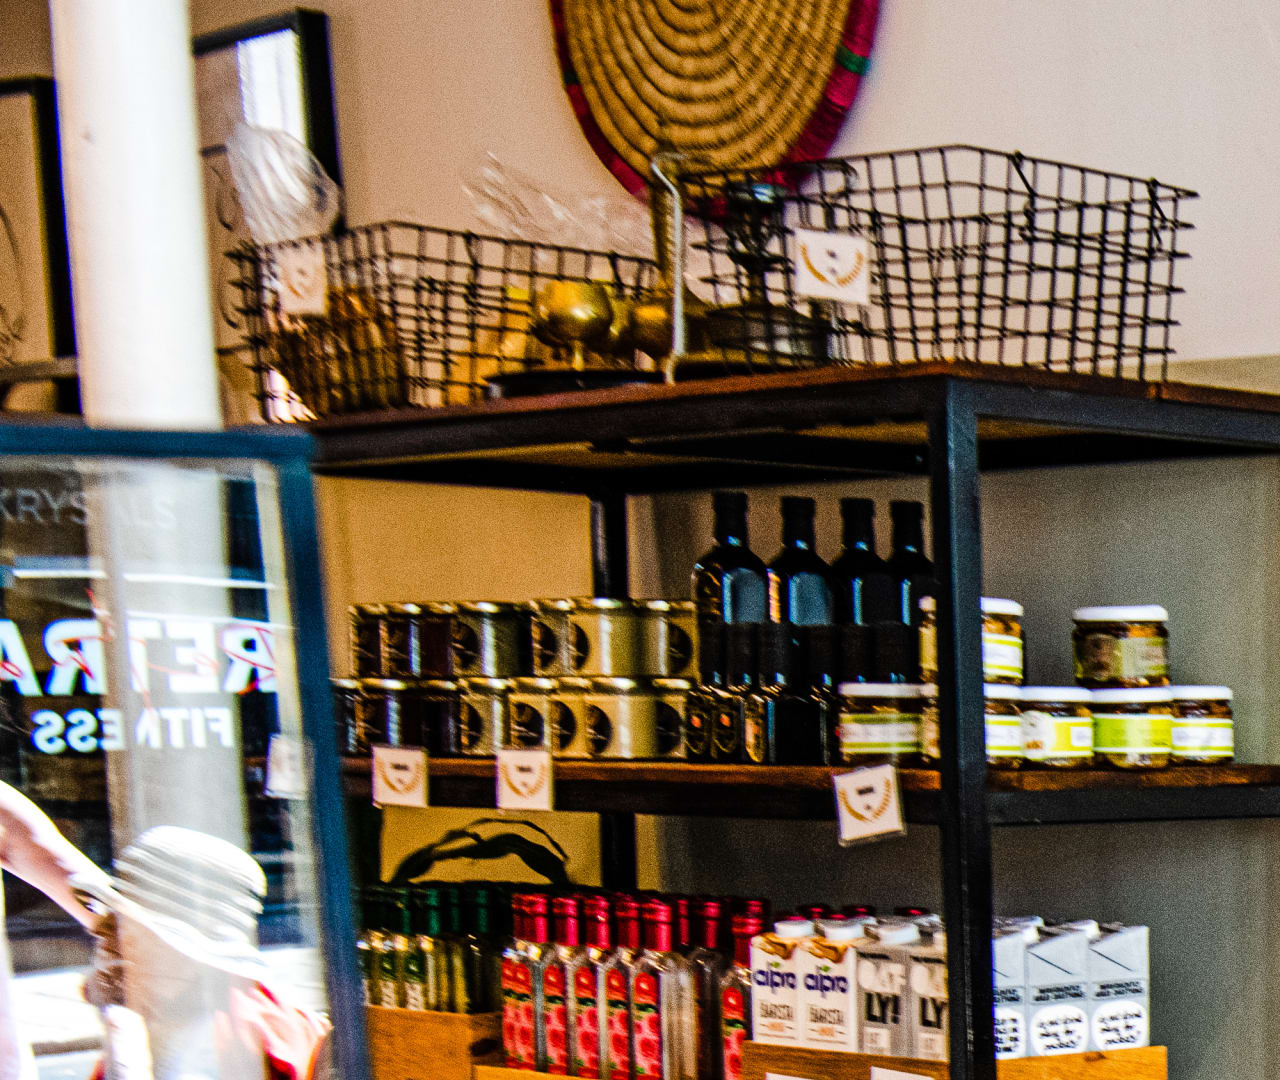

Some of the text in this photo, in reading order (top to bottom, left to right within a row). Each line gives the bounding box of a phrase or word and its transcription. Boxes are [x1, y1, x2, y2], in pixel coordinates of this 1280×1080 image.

[752, 961, 797, 995] alpro
[803, 966, 849, 999] alpro
[864, 992, 902, 1025] LY!
[920, 996, 949, 1030] LY
